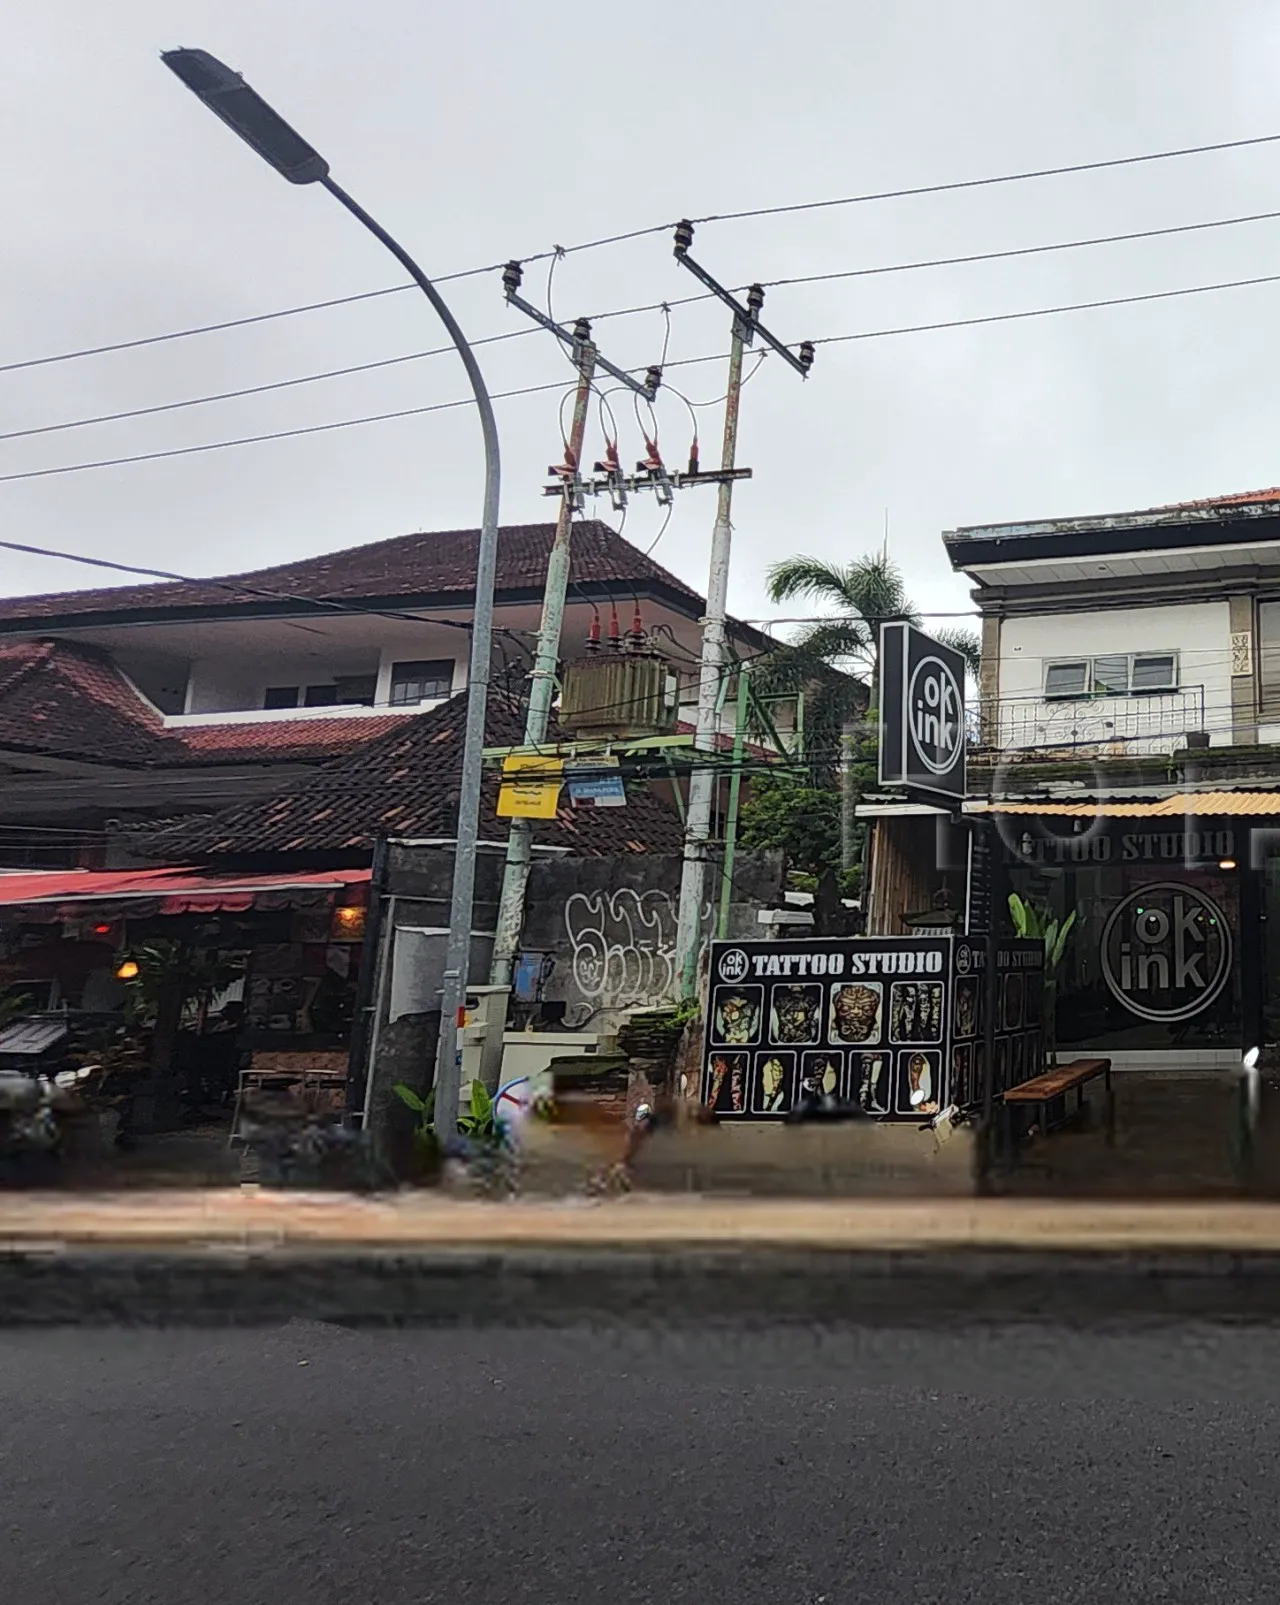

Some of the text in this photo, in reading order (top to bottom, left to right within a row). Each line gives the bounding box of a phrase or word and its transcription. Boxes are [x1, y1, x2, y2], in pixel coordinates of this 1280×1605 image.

[923, 671, 954, 715] ok
[916, 699, 954, 752] ink
[1122, 829, 1236, 861] STUDIO
[1135, 895, 1206, 945] ok
[722, 962, 743, 976] ink
[726, 951, 744, 965] ok
[752, 951, 943, 977] TATTOO STUDIO
[1120, 941, 1207, 990] ink
